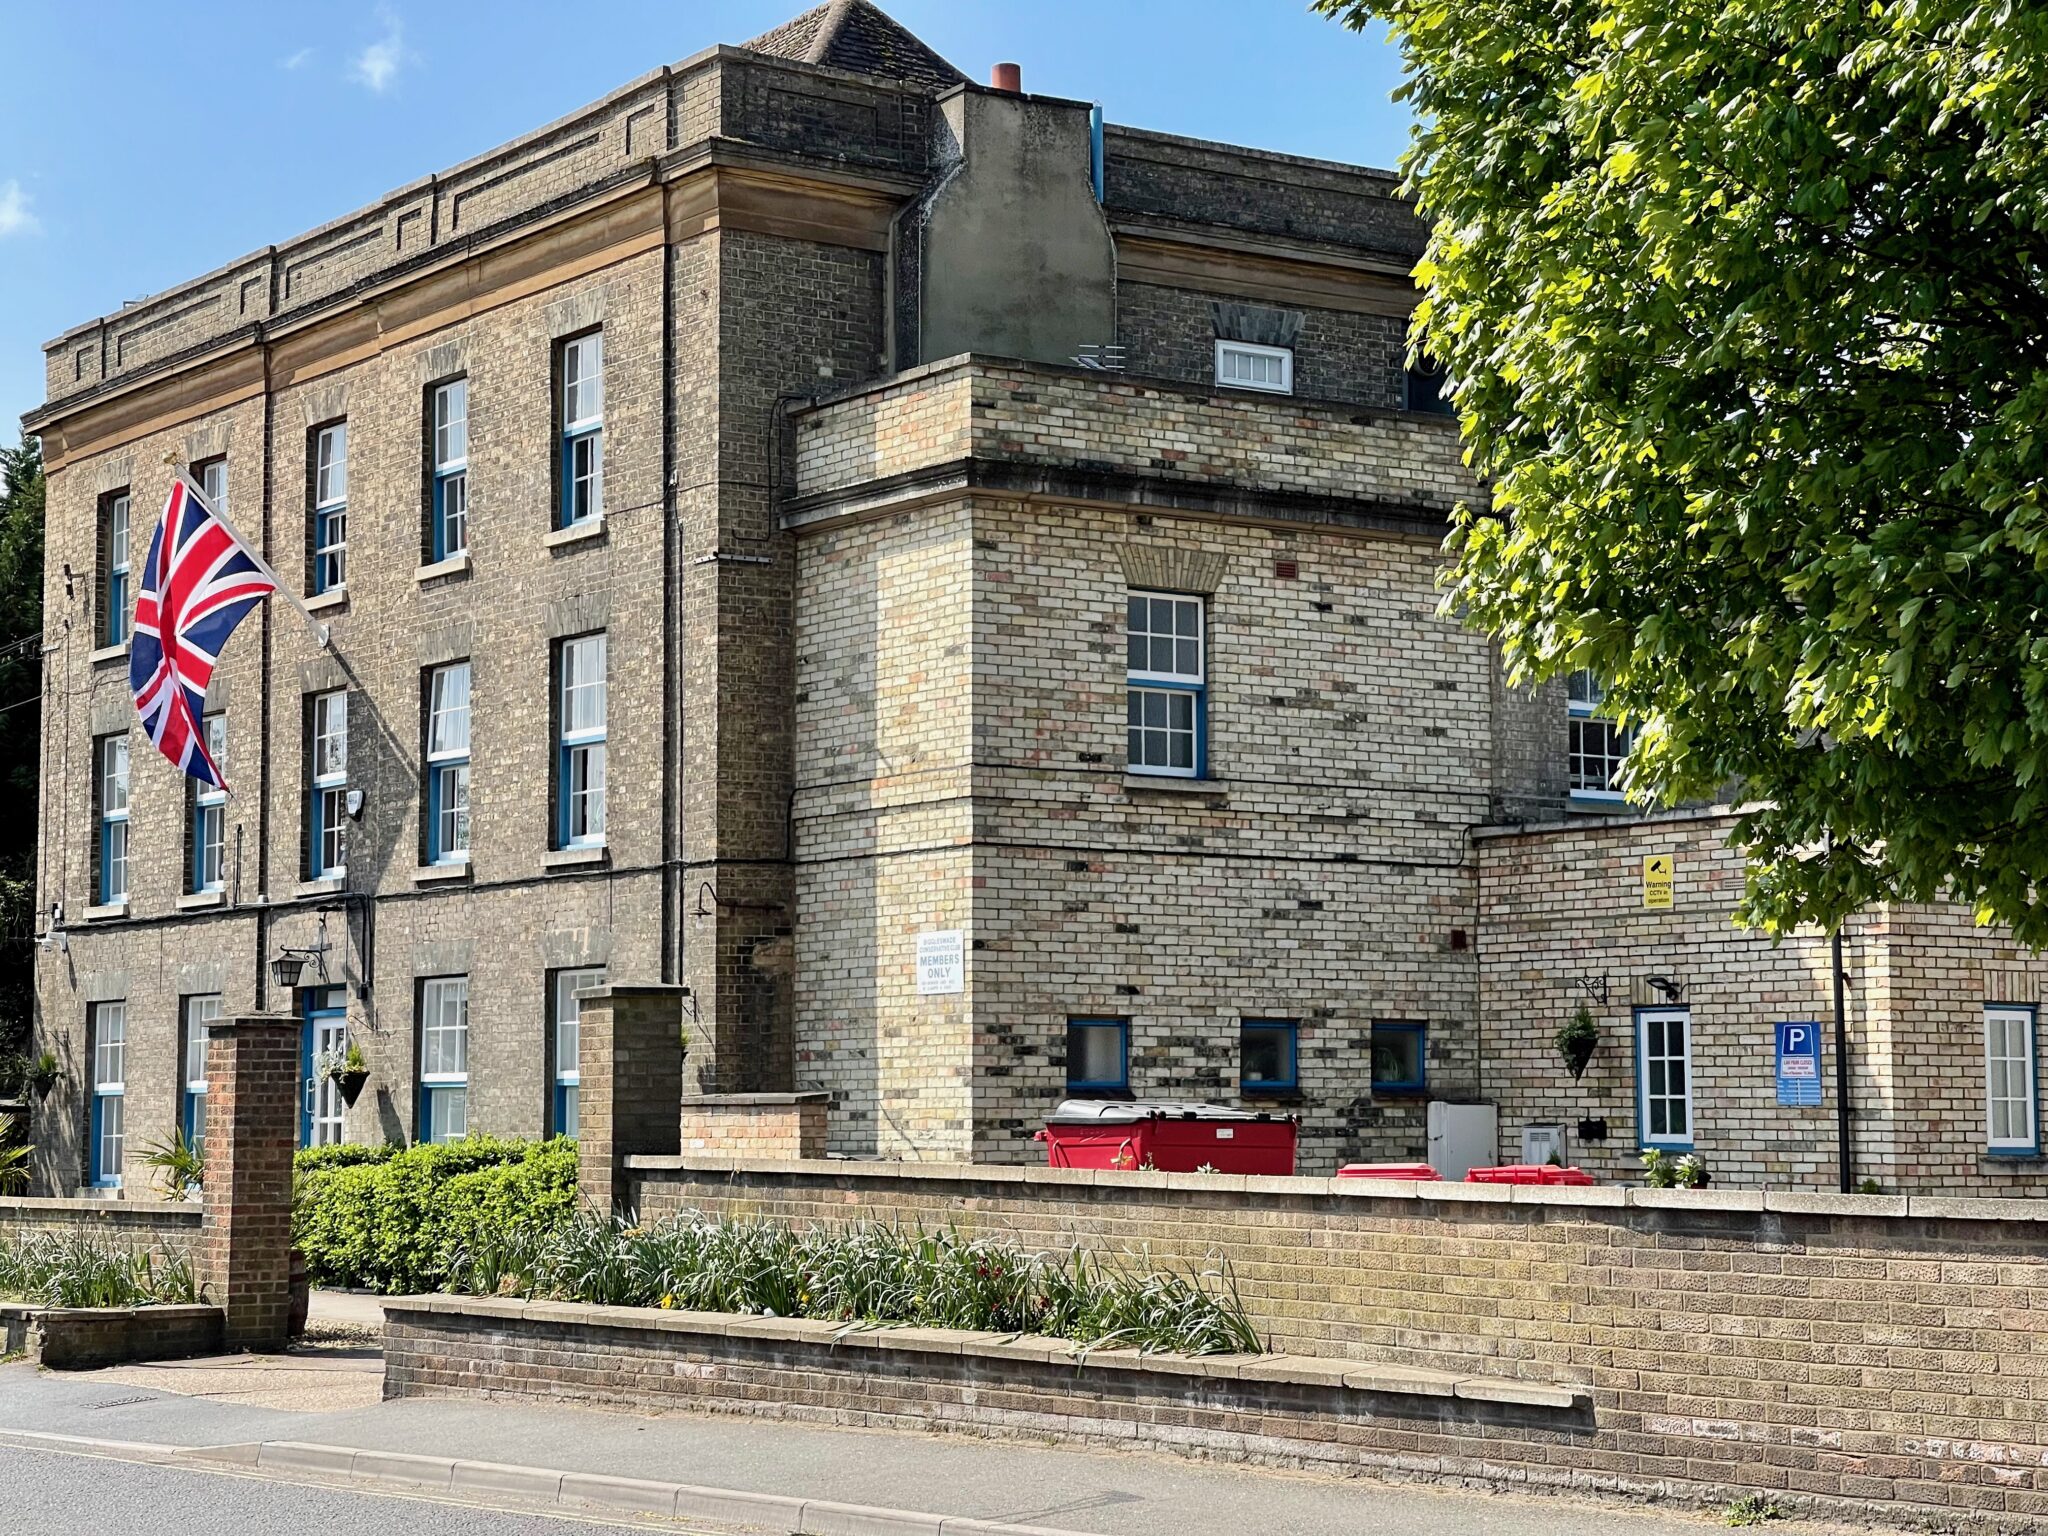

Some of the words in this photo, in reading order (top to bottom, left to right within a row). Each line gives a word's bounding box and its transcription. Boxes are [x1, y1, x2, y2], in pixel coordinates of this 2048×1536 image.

[1646, 881, 1671, 889] Warning
[920, 954, 959, 967] MEMBERS
[927, 967, 951, 978] ONLY
[1790, 1028, 1805, 1051] P
